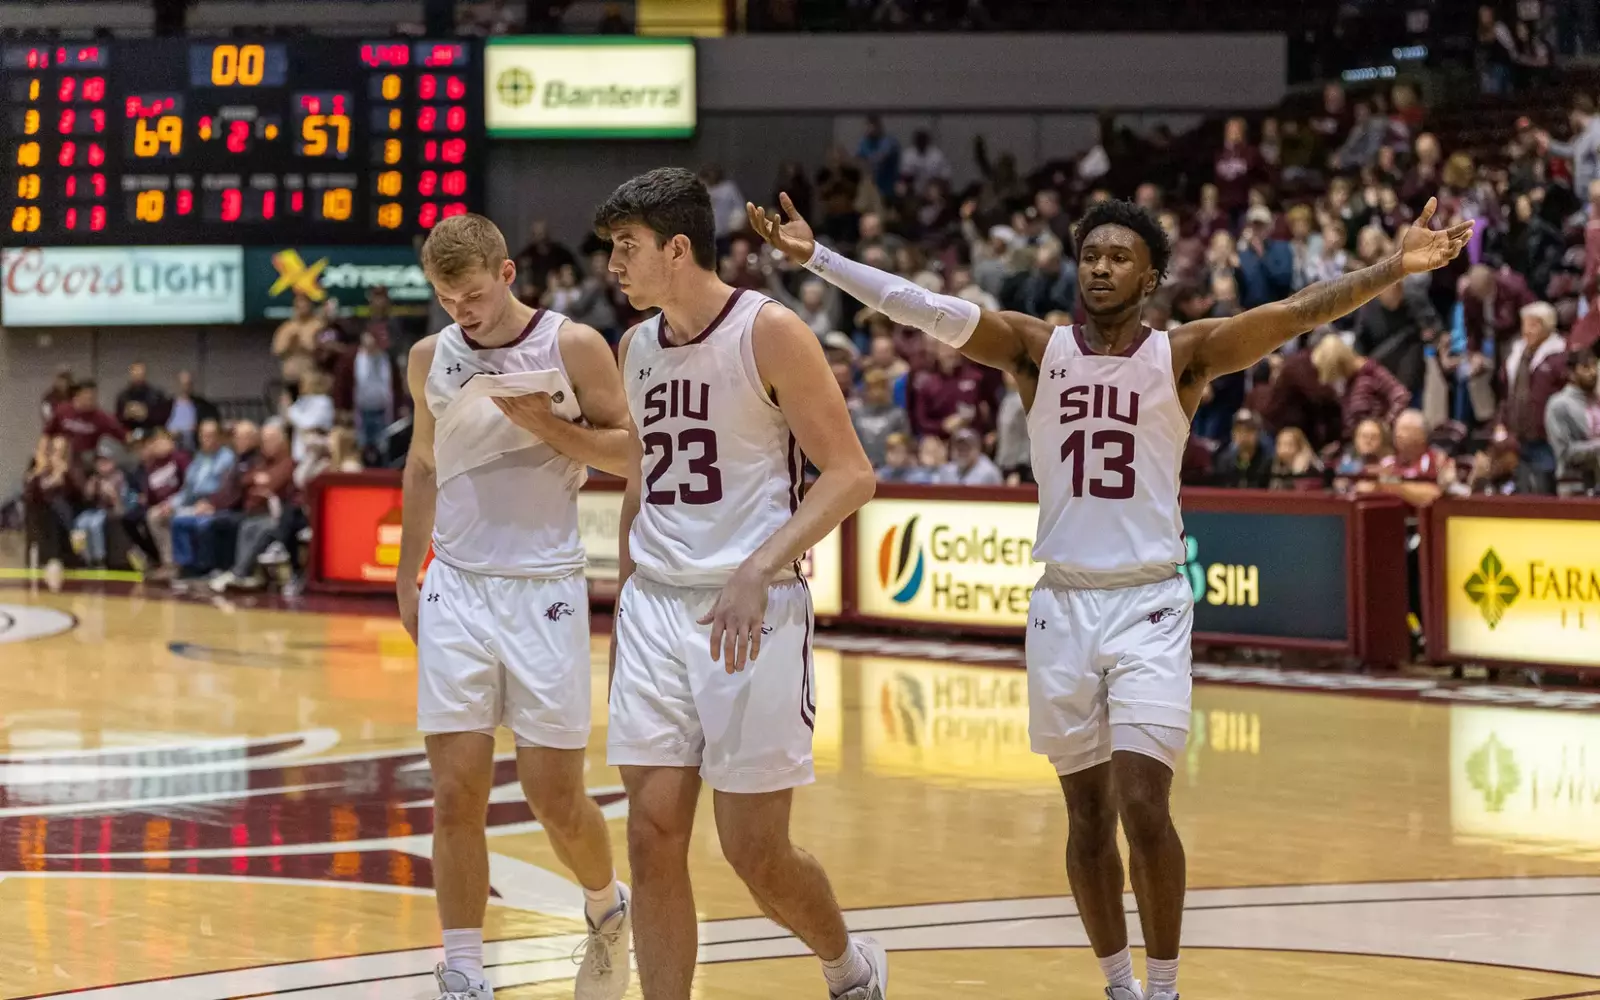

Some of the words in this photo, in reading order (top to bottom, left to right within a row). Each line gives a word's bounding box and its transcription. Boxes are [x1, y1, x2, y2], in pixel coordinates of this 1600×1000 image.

[212, 45, 264, 85] 00
[543, 80, 683, 109] Banterra
[135, 116, 182, 156] 69
[227, 121, 248, 152] 2
[303, 115, 349, 155] 57
[2, 247, 125, 296] Coors
[131, 264, 237, 294] LIGHT
[643, 380, 710, 428] SIU
[1060, 384, 1140, 425] SIU
[643, 428, 723, 506] 23
[1060, 429, 1136, 500] 13
[932, 525, 1034, 565] Golden
[1207, 564, 1258, 606] SIH
